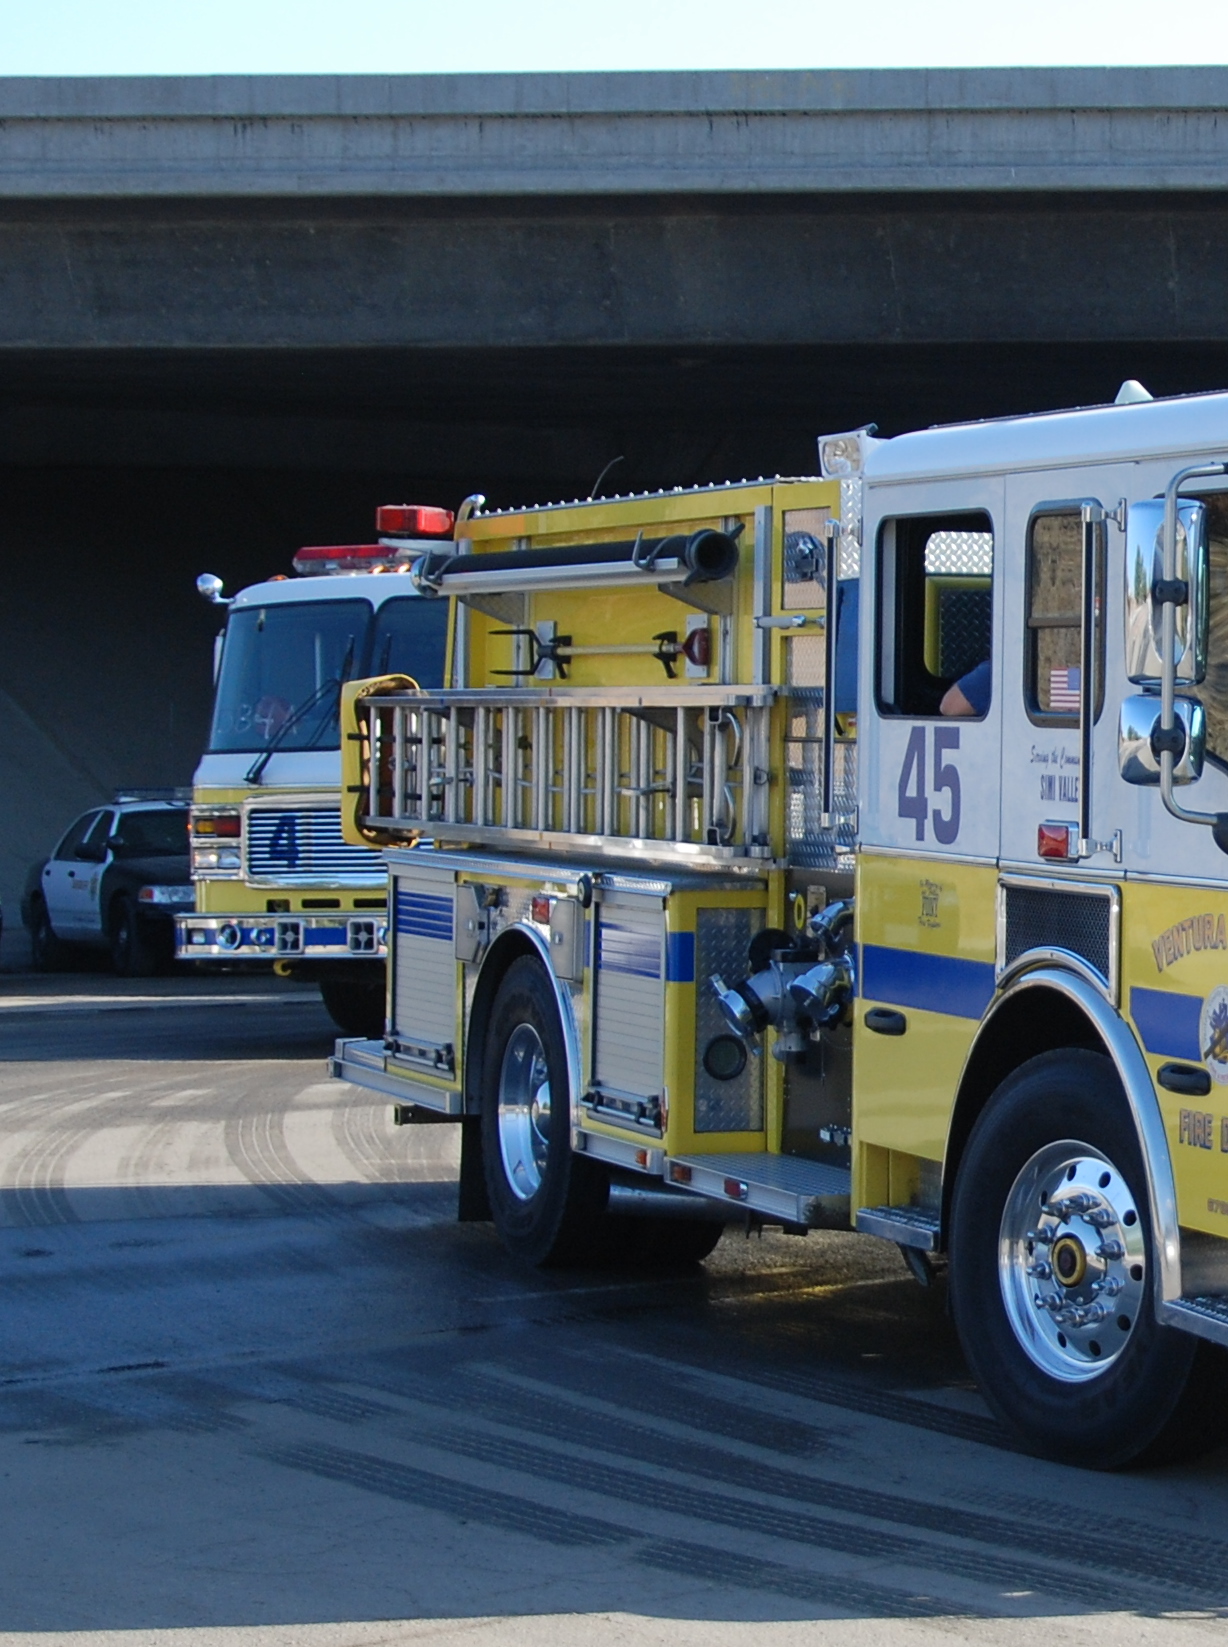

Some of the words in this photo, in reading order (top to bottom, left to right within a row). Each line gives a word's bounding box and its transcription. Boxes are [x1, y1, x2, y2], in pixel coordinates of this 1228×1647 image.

[898, 725, 961, 845] 45
[1040, 774, 1056, 801] SIMI
[1058, 775, 1079, 803] VALLE
[1151, 913, 1228, 973] VENTURA
[1179, 1108, 1213, 1150] FIRE
